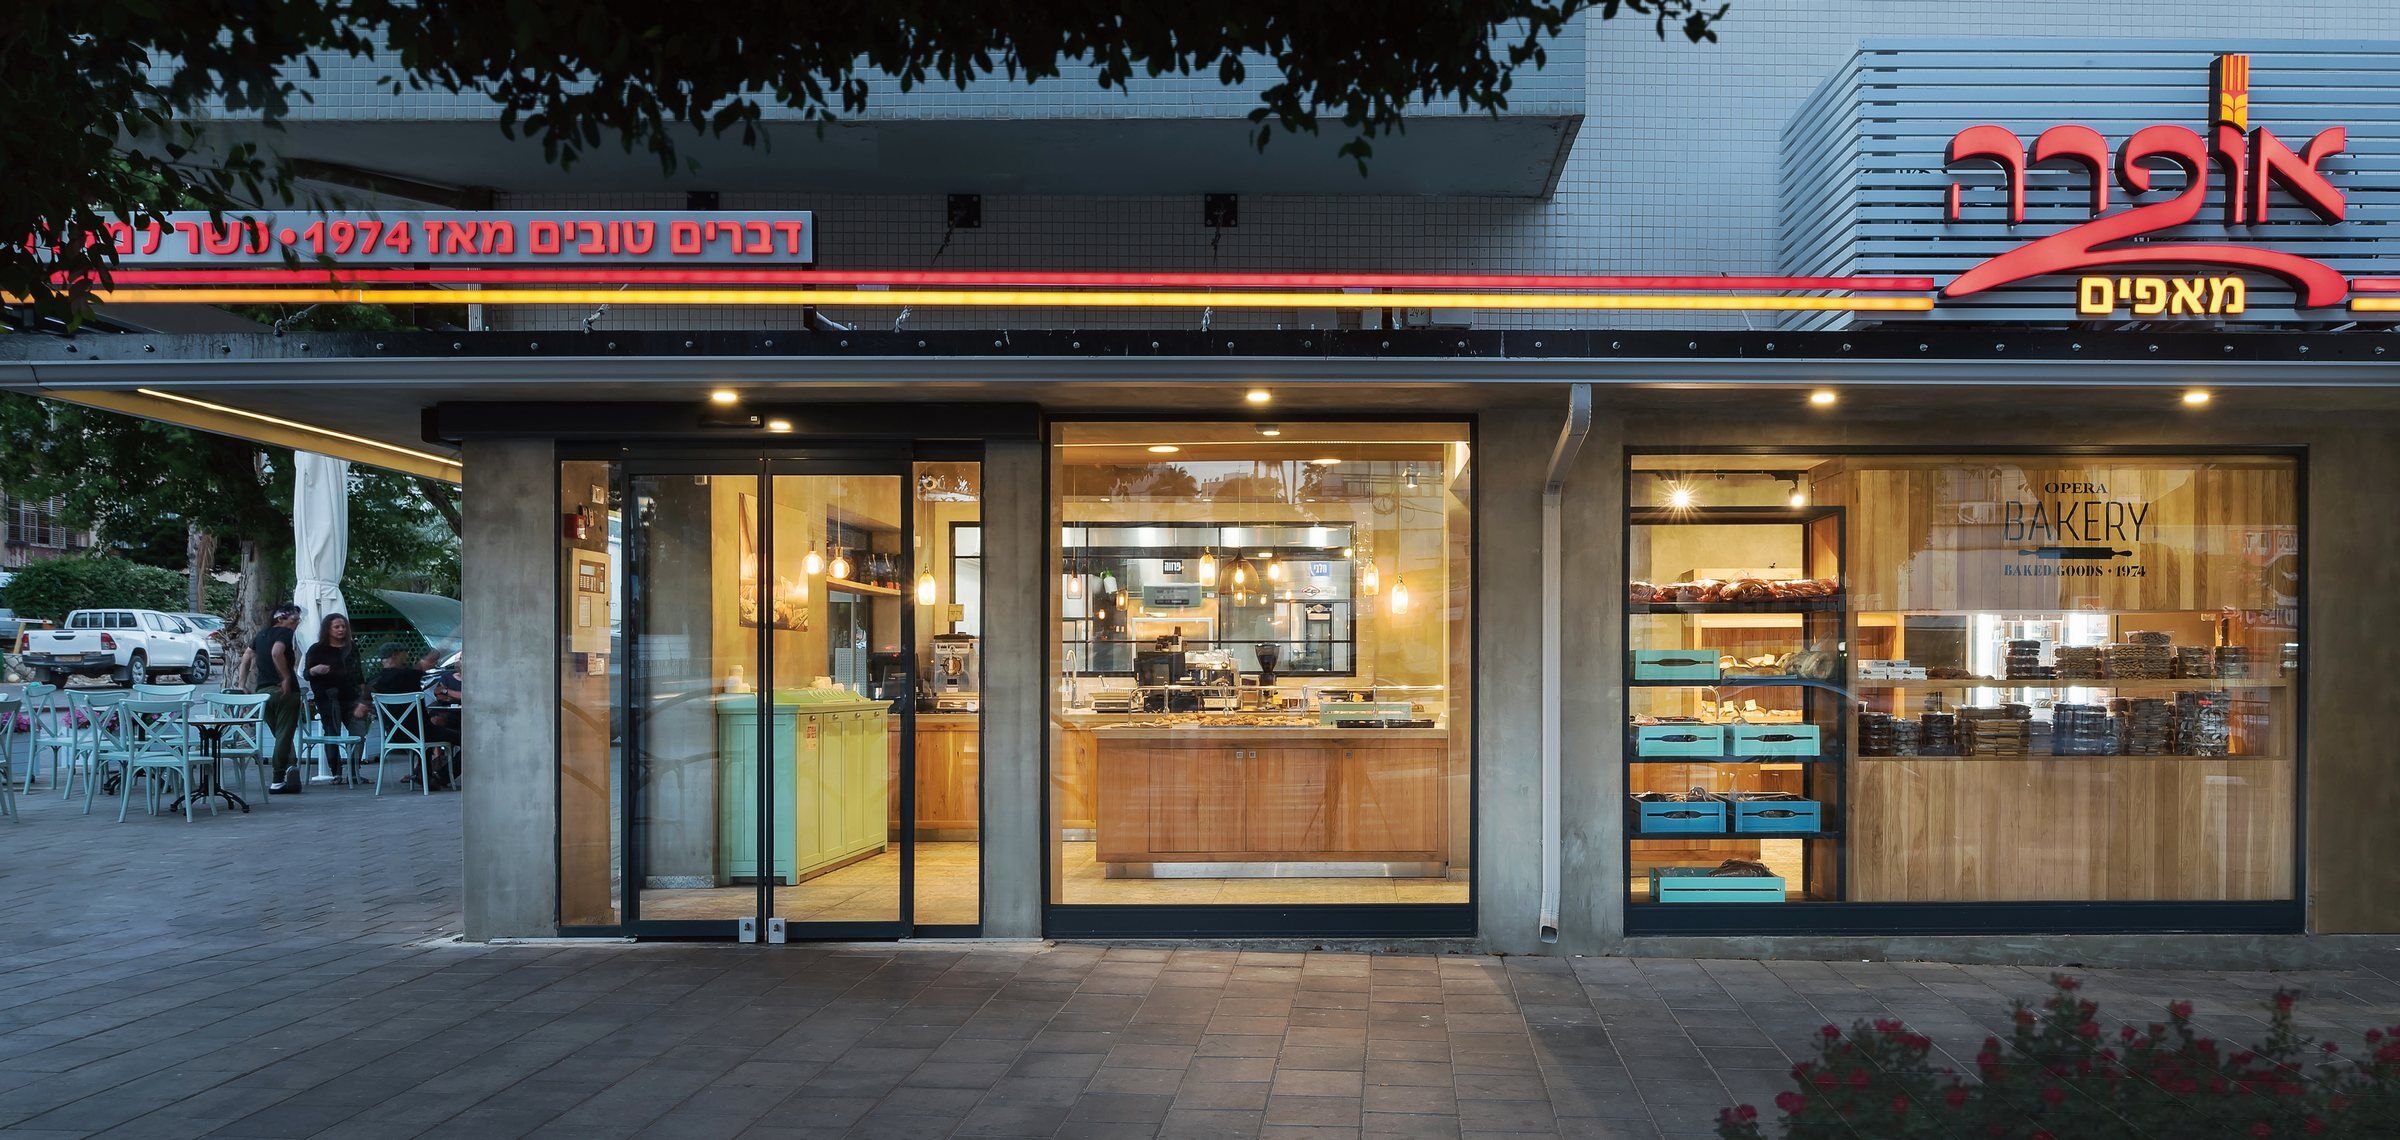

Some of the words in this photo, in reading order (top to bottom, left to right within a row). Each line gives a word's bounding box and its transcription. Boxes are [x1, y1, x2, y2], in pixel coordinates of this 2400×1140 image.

[1938, 118, 2348, 308] אופרה
[303, 220, 411, 255] 1974
[423, 219, 516, 255] מאז
[529, 219, 656, 255] טובים
[671, 219, 804, 255] דברים
[2078, 277, 2246, 315] מאפים
[2044, 482, 2109, 494] OPERA
[2003, 500, 2150, 542] BAKERY
[2003, 564, 2051, 577] BAKED
[2056, 565, 2104, 577] GOODS
[2115, 565, 2147, 578] 1974
